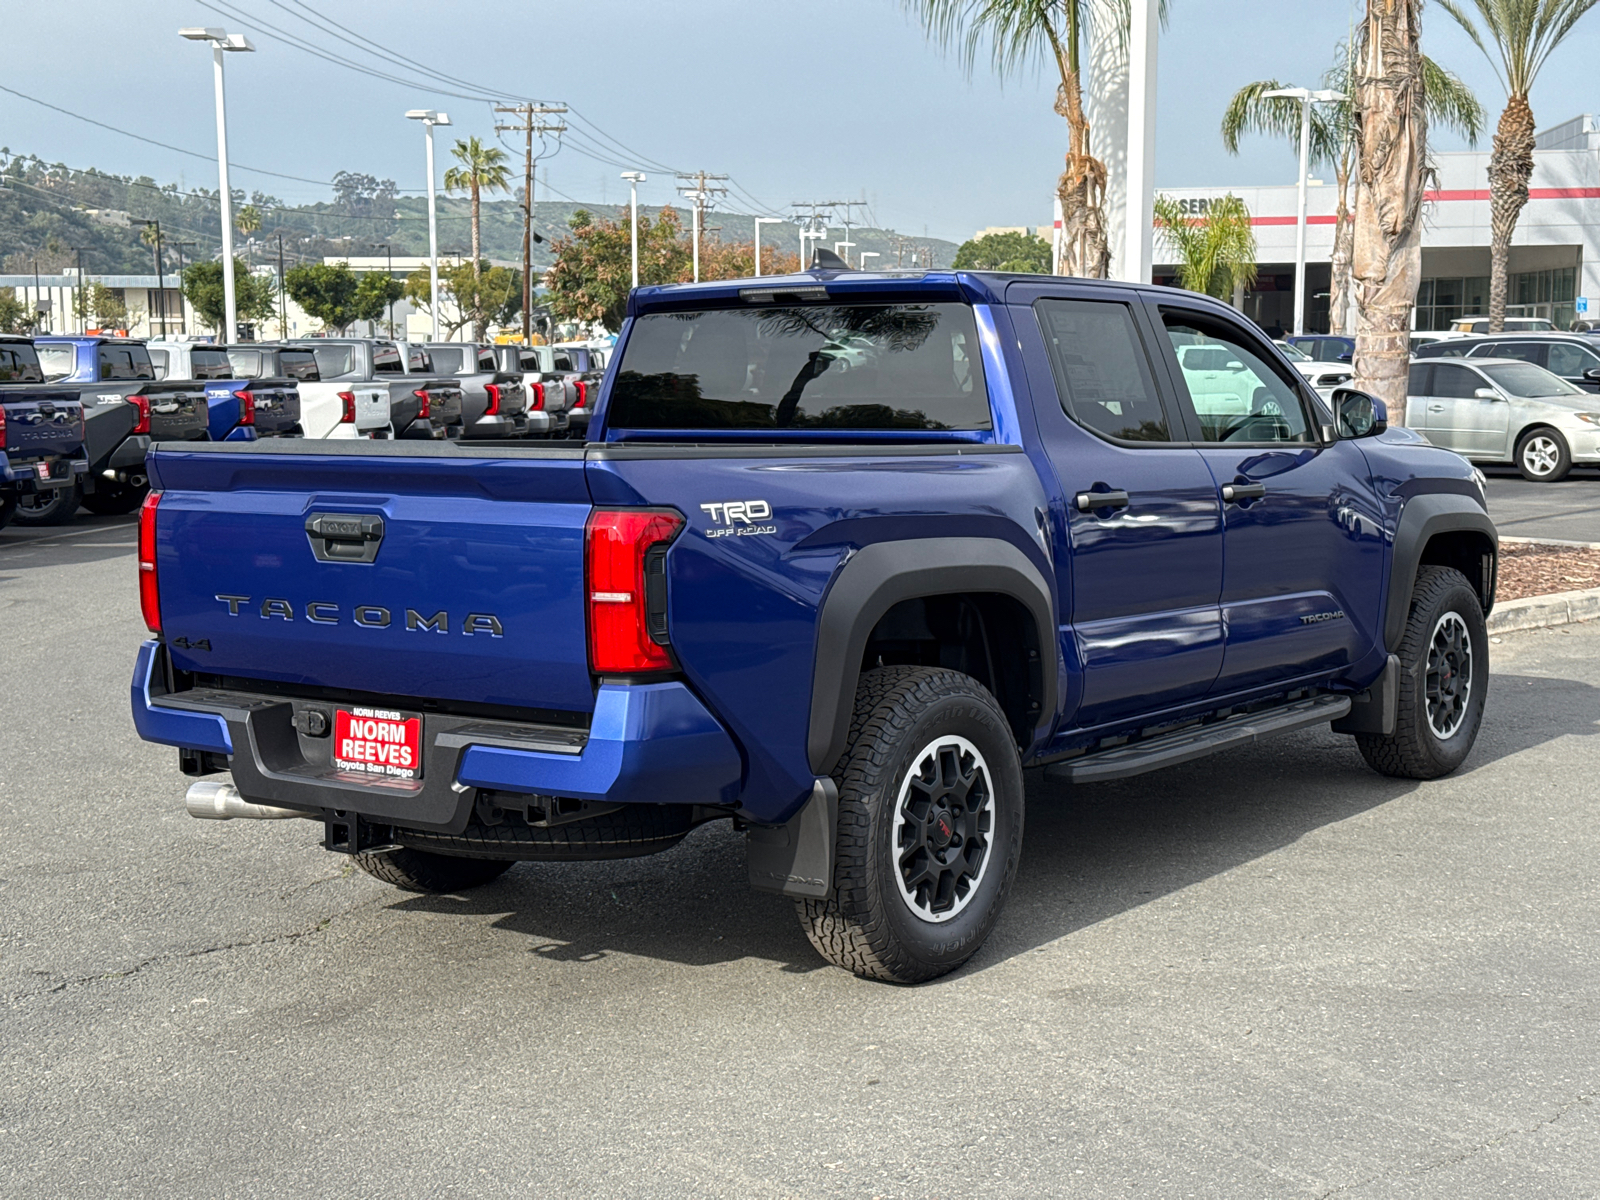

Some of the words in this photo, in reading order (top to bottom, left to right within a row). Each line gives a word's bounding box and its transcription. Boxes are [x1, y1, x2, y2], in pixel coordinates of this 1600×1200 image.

[21, 429, 74, 440] TACOMA
[700, 500, 773, 526] TRD
[323, 522, 359, 534] TOYOTA
[706, 528, 734, 537] OFF
[737, 525, 777, 536] ROAD
[214, 593, 504, 638] TACOMA
[1300, 610, 1345, 624] TACOMA
[353, 707, 374, 718] NORM
[375, 710, 400, 720] REEVES
[349, 719, 406, 744] NORM
[342, 739, 412, 765] REEVES
[335, 759, 365, 771] Toyota
[366, 762, 385, 774] San
[386, 765, 414, 778] Diego
